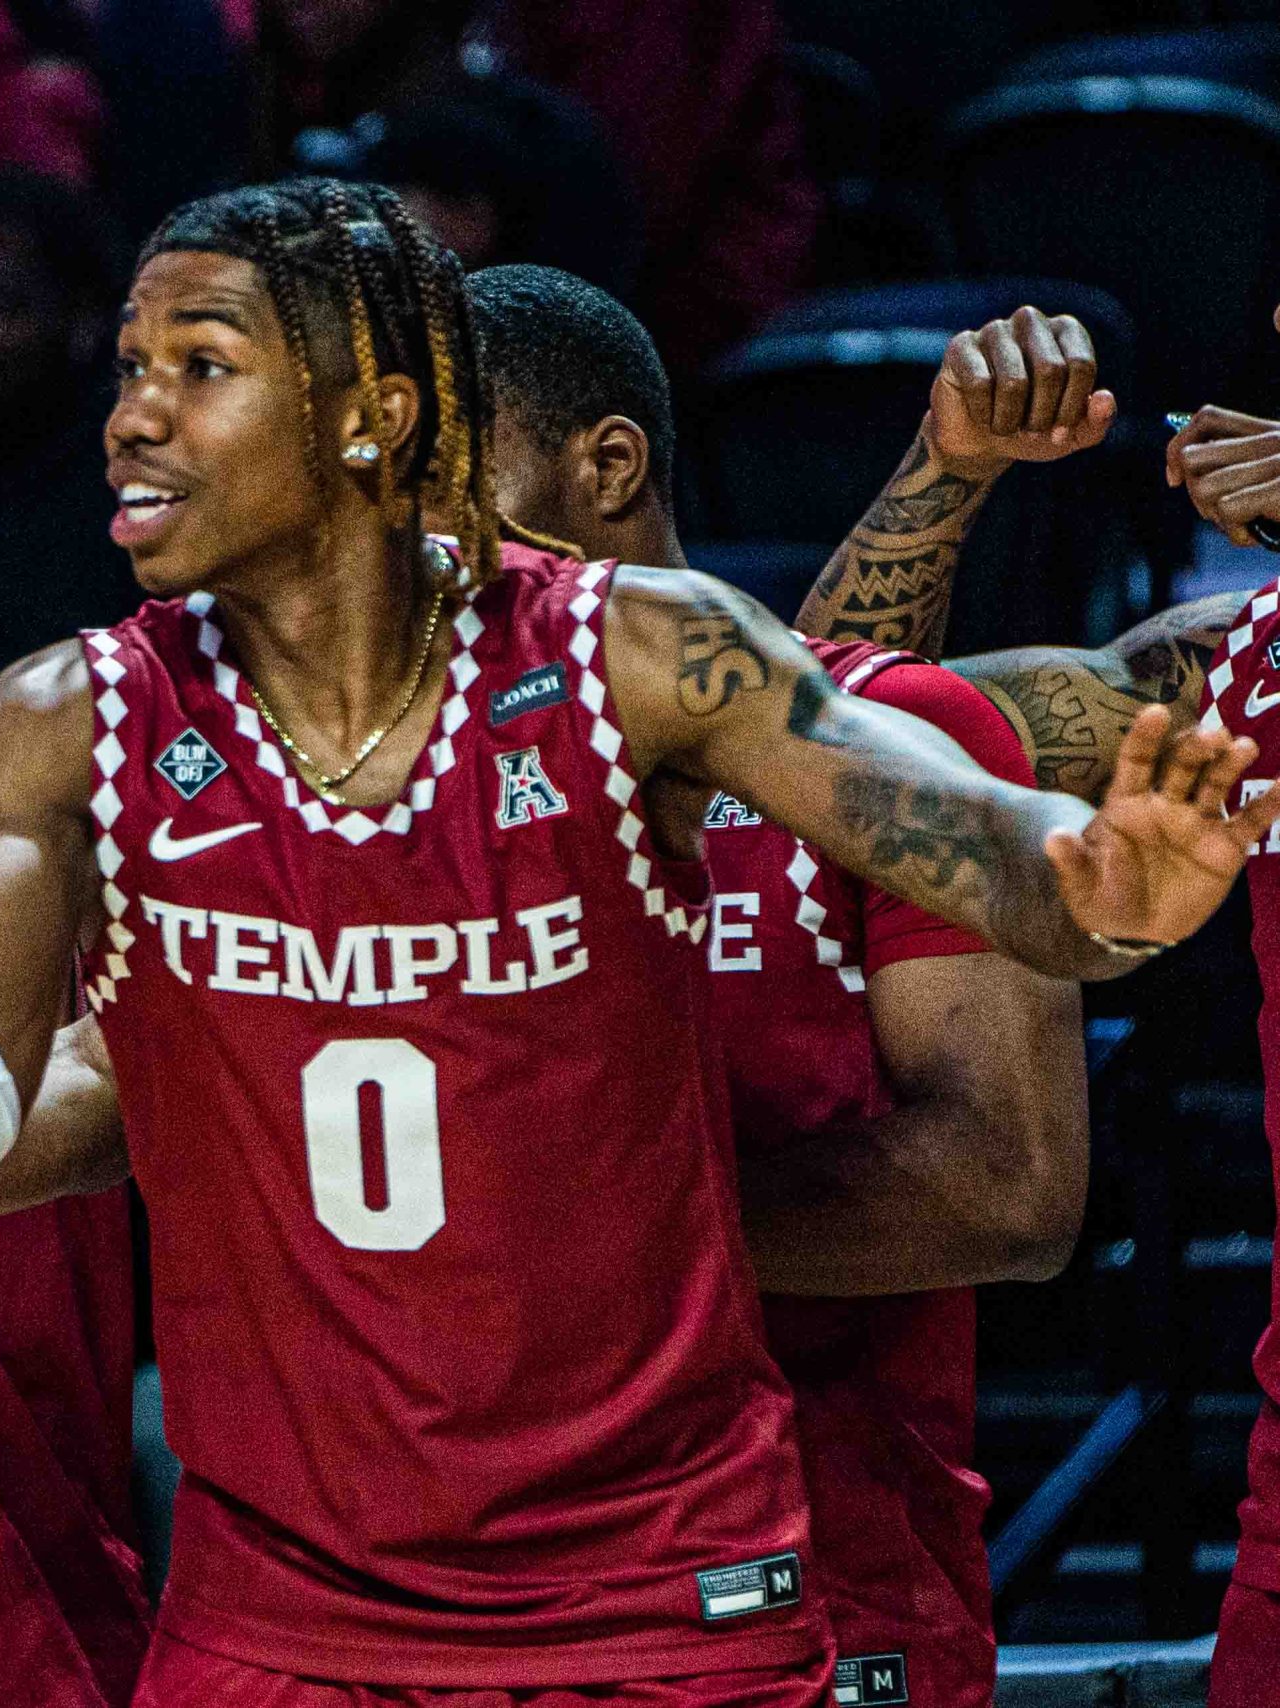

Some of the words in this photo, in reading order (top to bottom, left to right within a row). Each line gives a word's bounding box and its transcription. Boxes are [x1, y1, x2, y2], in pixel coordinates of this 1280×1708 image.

[139, 894, 590, 1006] TEMPLE
[301, 1038, 446, 1251] 0
[772, 1569, 792, 1594] M
[872, 1669, 893, 1691] M
